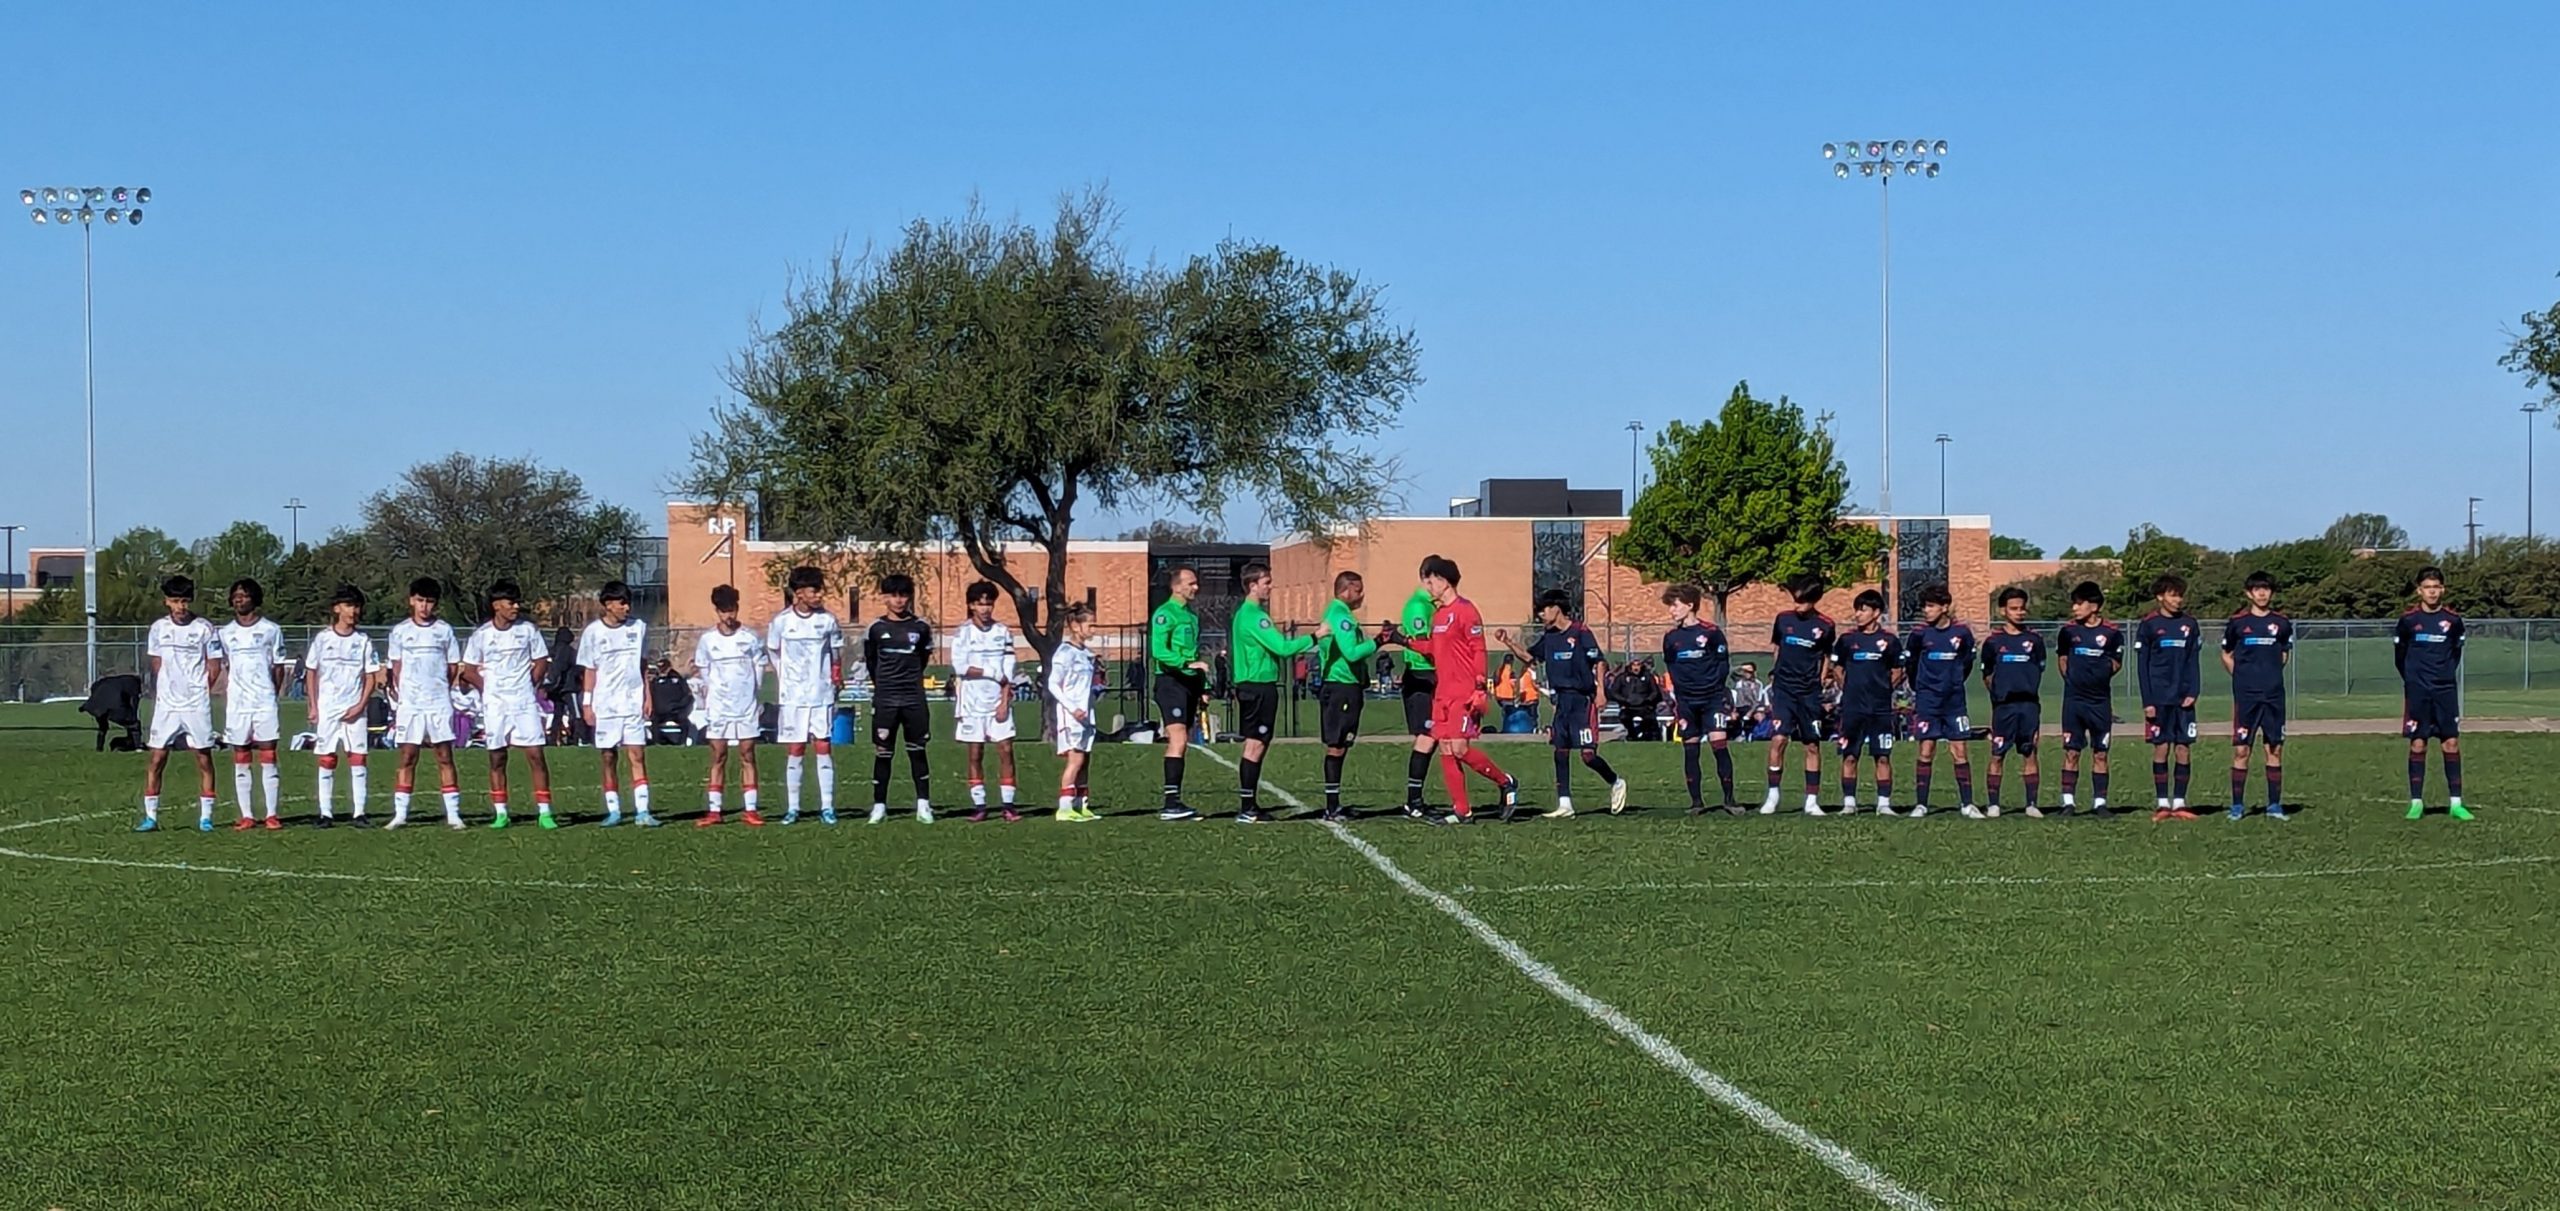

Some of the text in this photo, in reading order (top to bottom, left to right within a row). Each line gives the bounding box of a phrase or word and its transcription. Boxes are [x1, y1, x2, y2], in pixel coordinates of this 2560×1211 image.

[1579, 728, 1593, 745] 10
[2187, 721, 2197, 738] 6
[1878, 733, 1893, 749] 16
